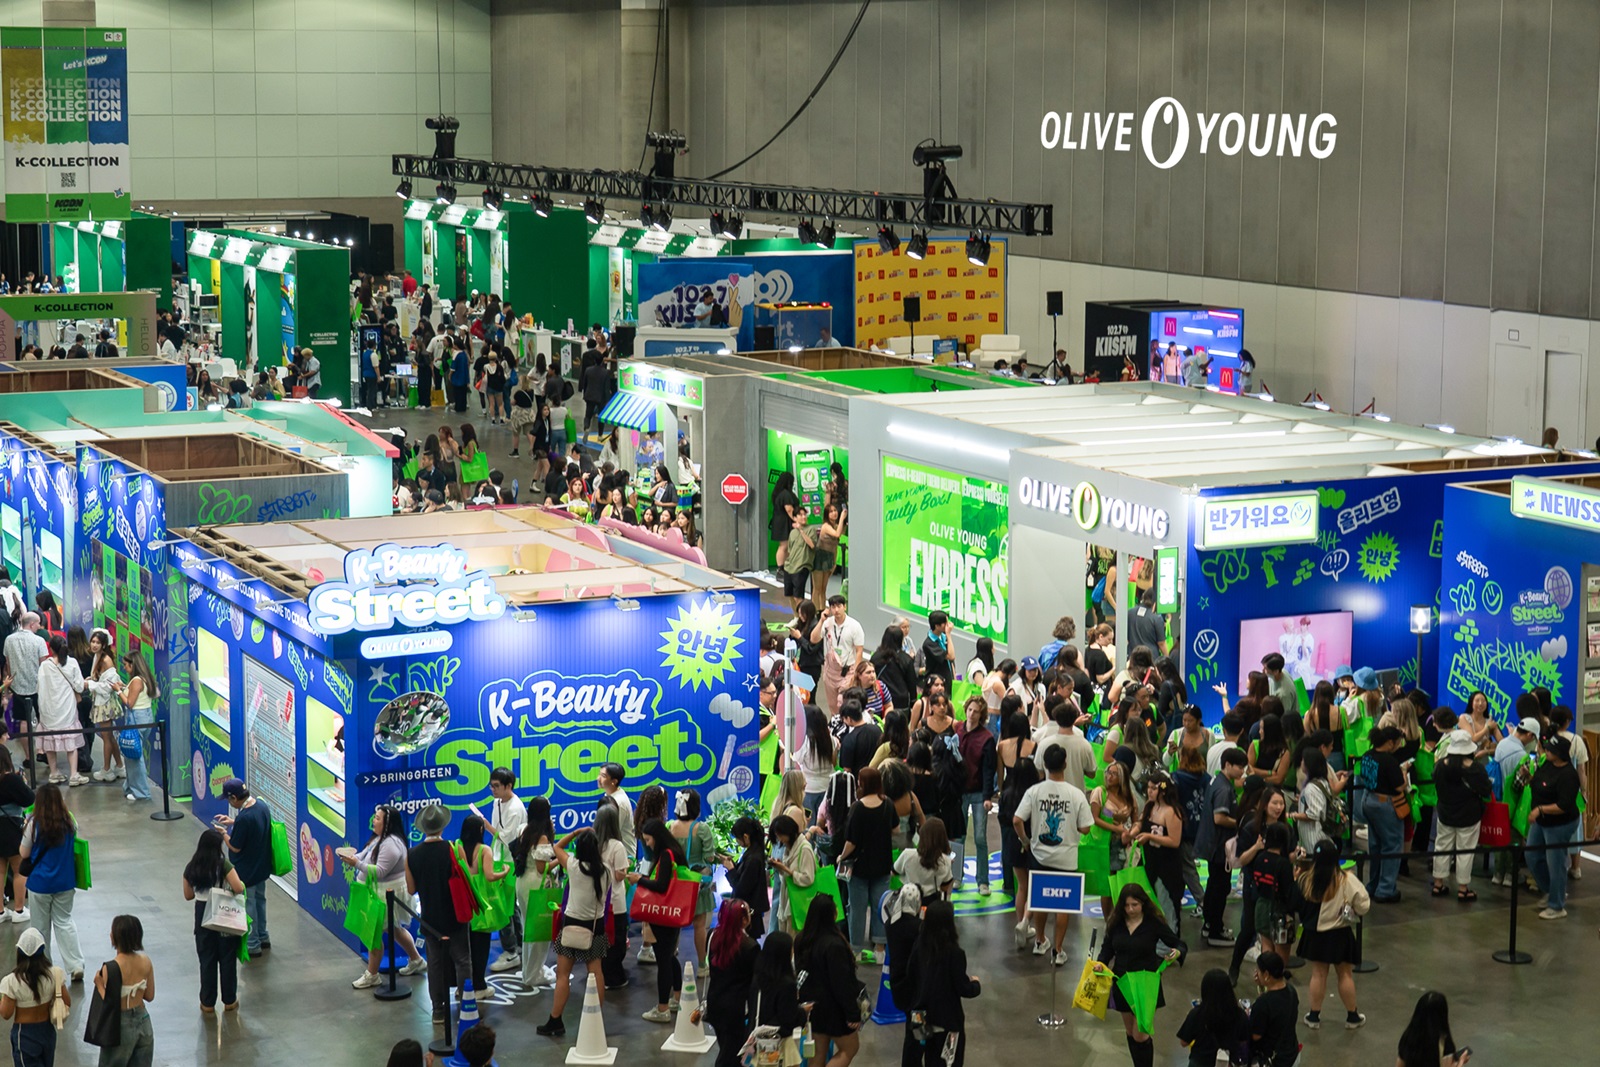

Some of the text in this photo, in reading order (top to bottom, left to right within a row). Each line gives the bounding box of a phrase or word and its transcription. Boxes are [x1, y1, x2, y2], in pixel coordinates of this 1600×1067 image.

[63, 60, 83, 70] Let's
[10, 89, 121, 99] K-COLLECTION
[11, 100, 121, 110] K-COLLECTION
[11, 111, 122, 122] K-COLLECTION
[1040, 111, 1134, 151] OLIVE
[1196, 112, 1338, 159] YOUNG
[15, 156, 119, 167] K-COLLECTION
[34, 303, 114, 312] K-COLLECTION
[140, 318, 149, 352] HELLO
[1095, 335, 1137, 357] KIISFM
[633, 373, 687, 396] BEAUTY BOX
[1019, 476, 1072, 515] OLIVE
[1100, 495, 1168, 539] YOUNG
[1209, 504, 1289, 531] 반가워요
[1338, 488, 1400, 533] 올리브영
[929, 521, 987, 551] OLIVE YOUNG
[352, 550, 464, 585] K-Beauty
[1366, 548, 1392, 567] 안녕
[910, 537, 1006, 633] EXPRESS
[316, 578, 500, 629] Street.
[1512, 603, 1562, 621] Street.
[369, 638, 398, 654] OLIVE
[413, 635, 447, 649] YOUNG
[677, 629, 728, 664] 안녕
[488, 678, 650, 730] K-Beauty
[435, 720, 704, 796] Street.
[380, 767, 452, 783] BRINGGREEN
[1482, 825, 1503, 836] RTIR
[1042, 887, 1071, 898] EXIT
[219, 905, 241, 913] MOIRA
[641, 902, 681, 917] TIRTIR
